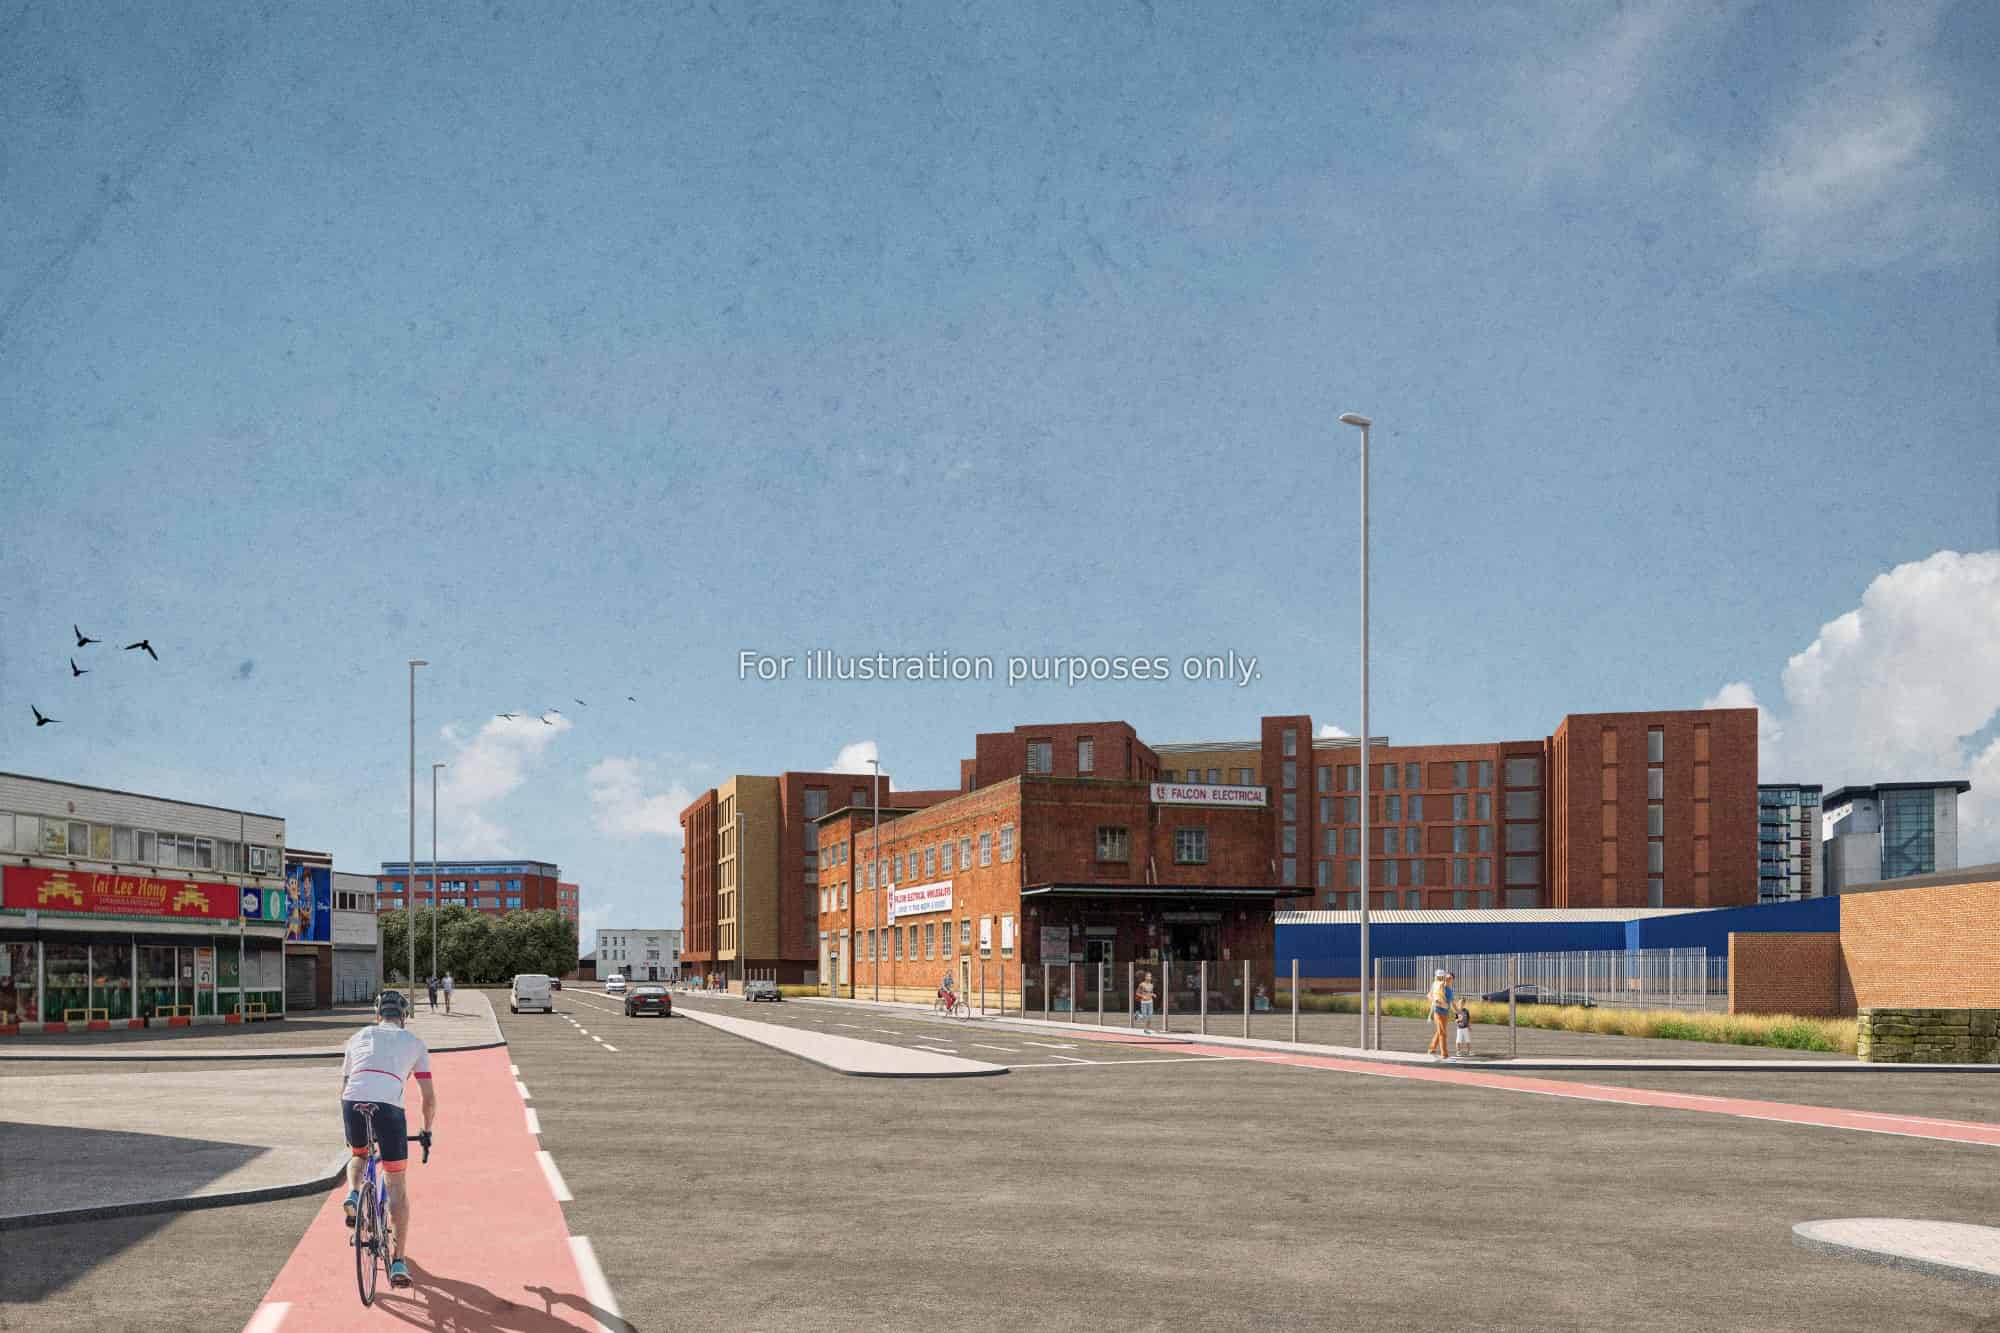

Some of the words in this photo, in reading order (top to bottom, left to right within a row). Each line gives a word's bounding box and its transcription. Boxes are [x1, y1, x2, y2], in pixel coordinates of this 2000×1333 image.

[1171, 788, 1207, 800] FALCON
[1212, 789, 1264, 801] ELECTRICAL
[113, 876, 134, 896] Lee
